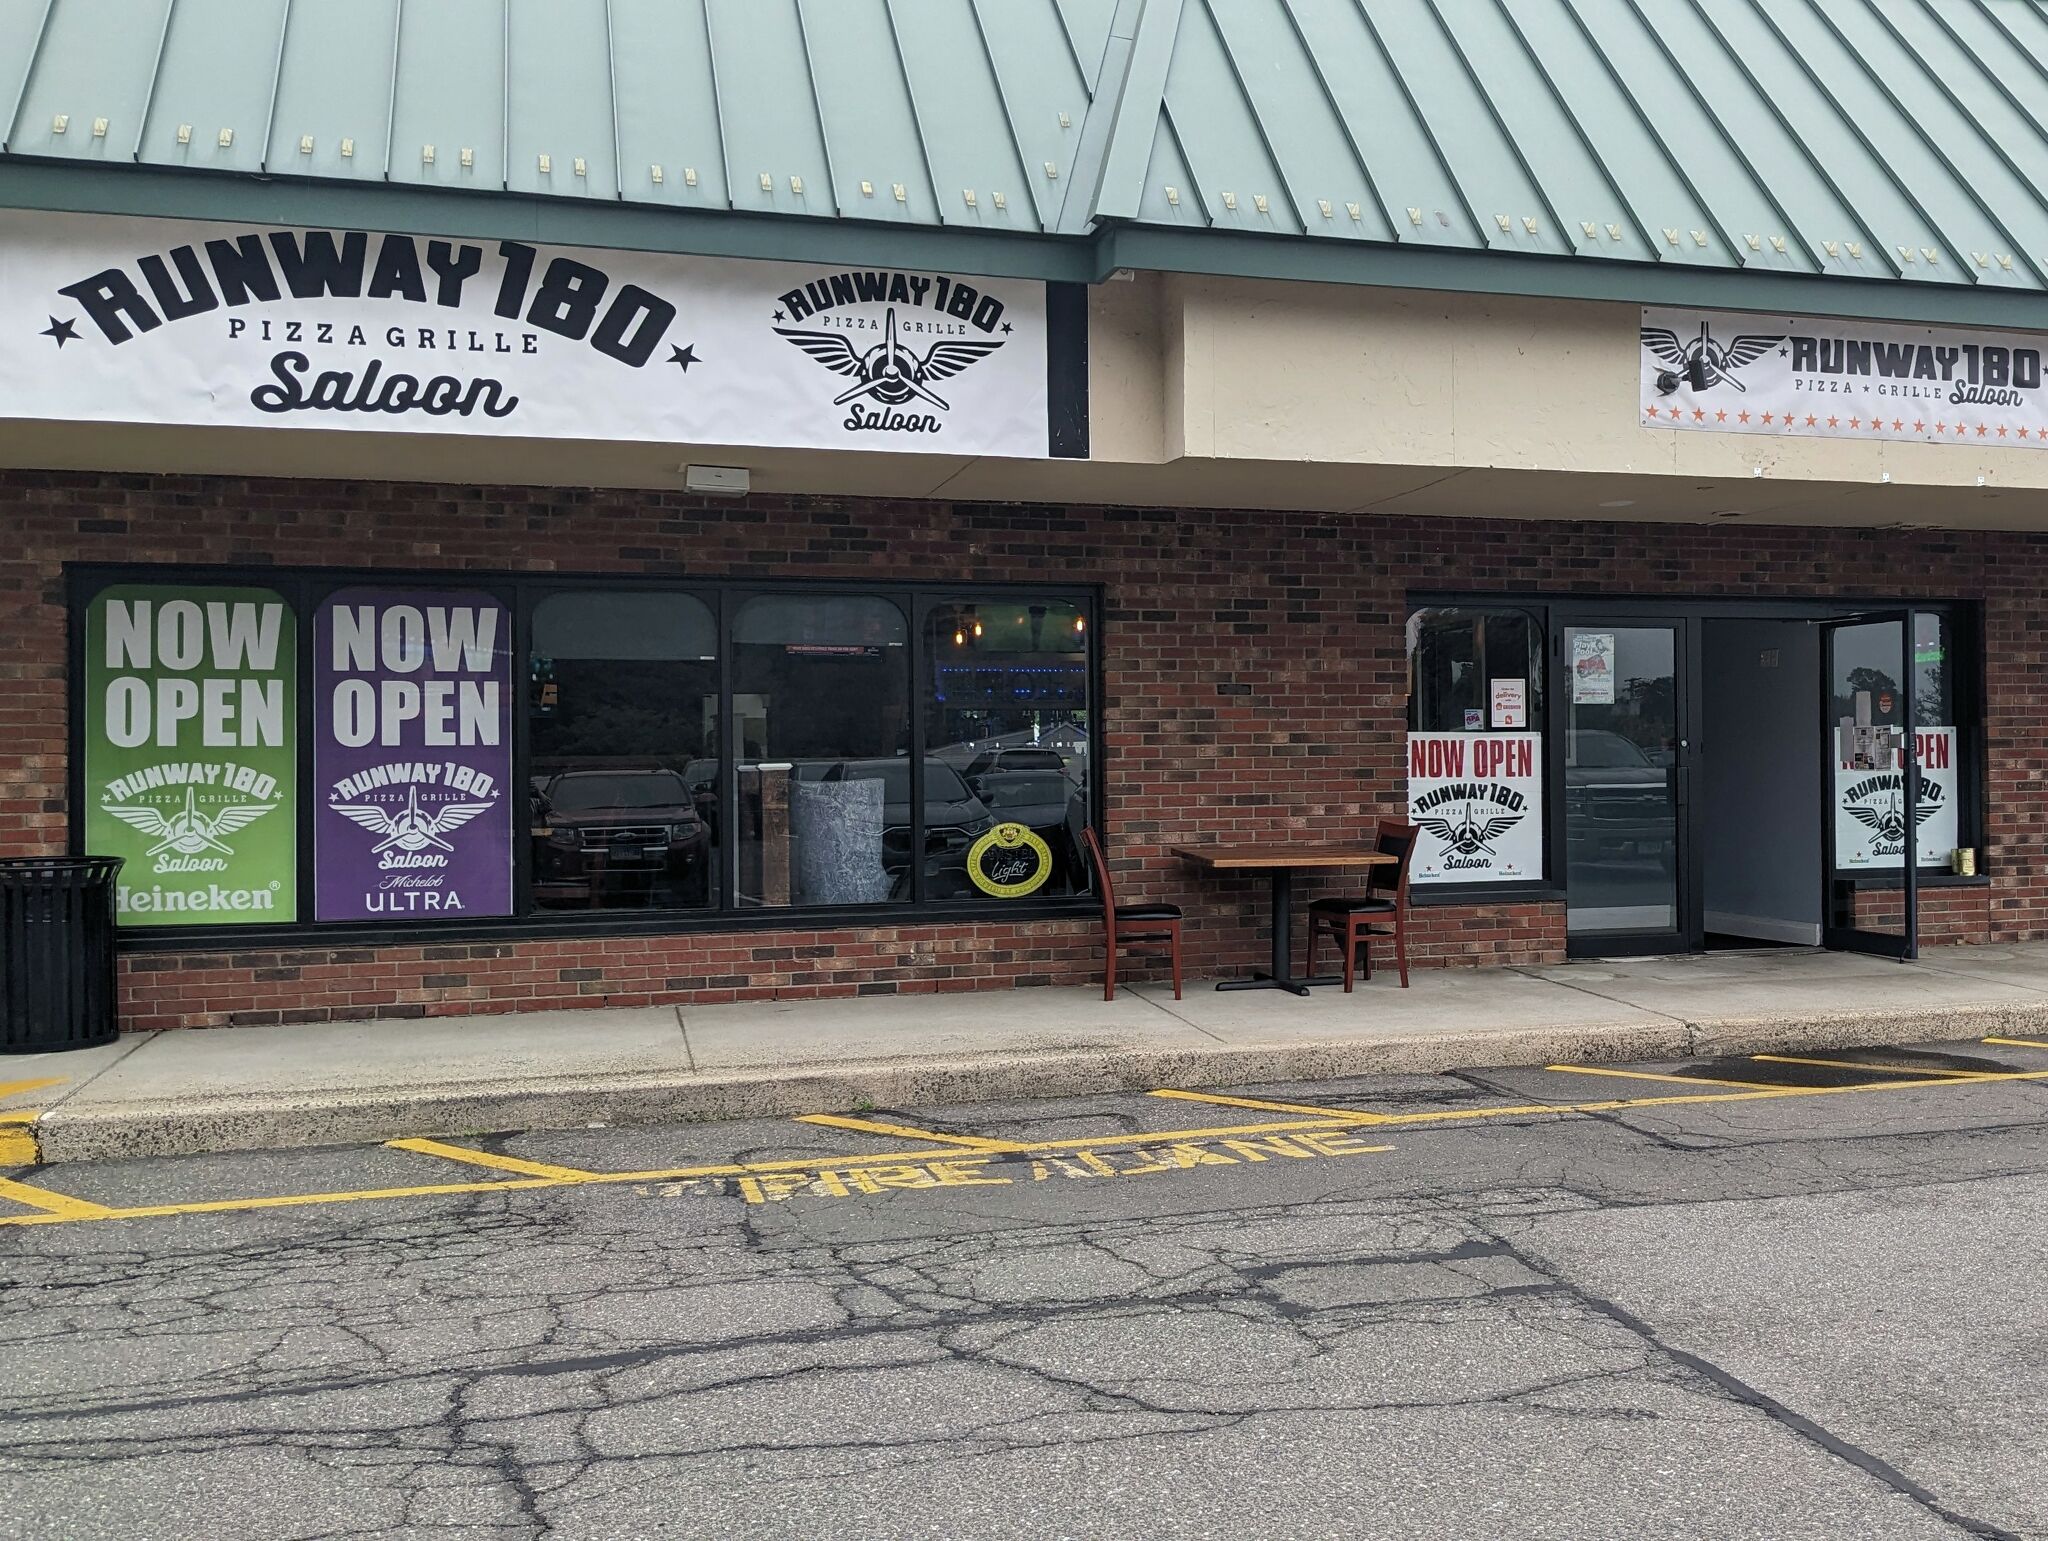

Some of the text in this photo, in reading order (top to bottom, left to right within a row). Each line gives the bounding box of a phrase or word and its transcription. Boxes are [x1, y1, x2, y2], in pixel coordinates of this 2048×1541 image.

[57, 231, 677, 368] RUNWAY 180
[778, 272, 1005, 333] RUNWAY 180
[228, 318, 539, 354] PIZZA GRILLE
[824, 316, 966, 335] PIZZA GRILLE
[250, 351, 520, 418] Saloon
[1795, 379, 1942, 399] PIZZA GRILLE
[1949, 378, 2024, 408] Saloon
[843, 403, 942, 433] Saloon
[105, 600, 283, 670] NOW
[332, 605, 498, 673] NOW
[105, 676, 284, 747] OPEN
[332, 678, 500, 747] OPEN
[1411, 739, 1532, 778] NOW OPEN
[105, 762, 277, 802] RUNWAY 180
[333, 762, 494, 801] RUNWAY 180
[1844, 774, 1943, 804] RUNWA 80
[139, 794, 247, 803] PIZZA GRILLE
[365, 793, 466, 802] PIZZA GRILLE
[1413, 782, 1525, 814] RUNWAY 180
[153, 853, 228, 873] Saloon
[378, 850, 448, 869] Saloon
[1443, 855, 1492, 870] Saloon
[1872, 842, 1905, 856] Saloo
[379, 874, 446, 889] Michelob
[991, 861, 1028, 883] Light
[738, 1158, 1013, 1203] FIRE
